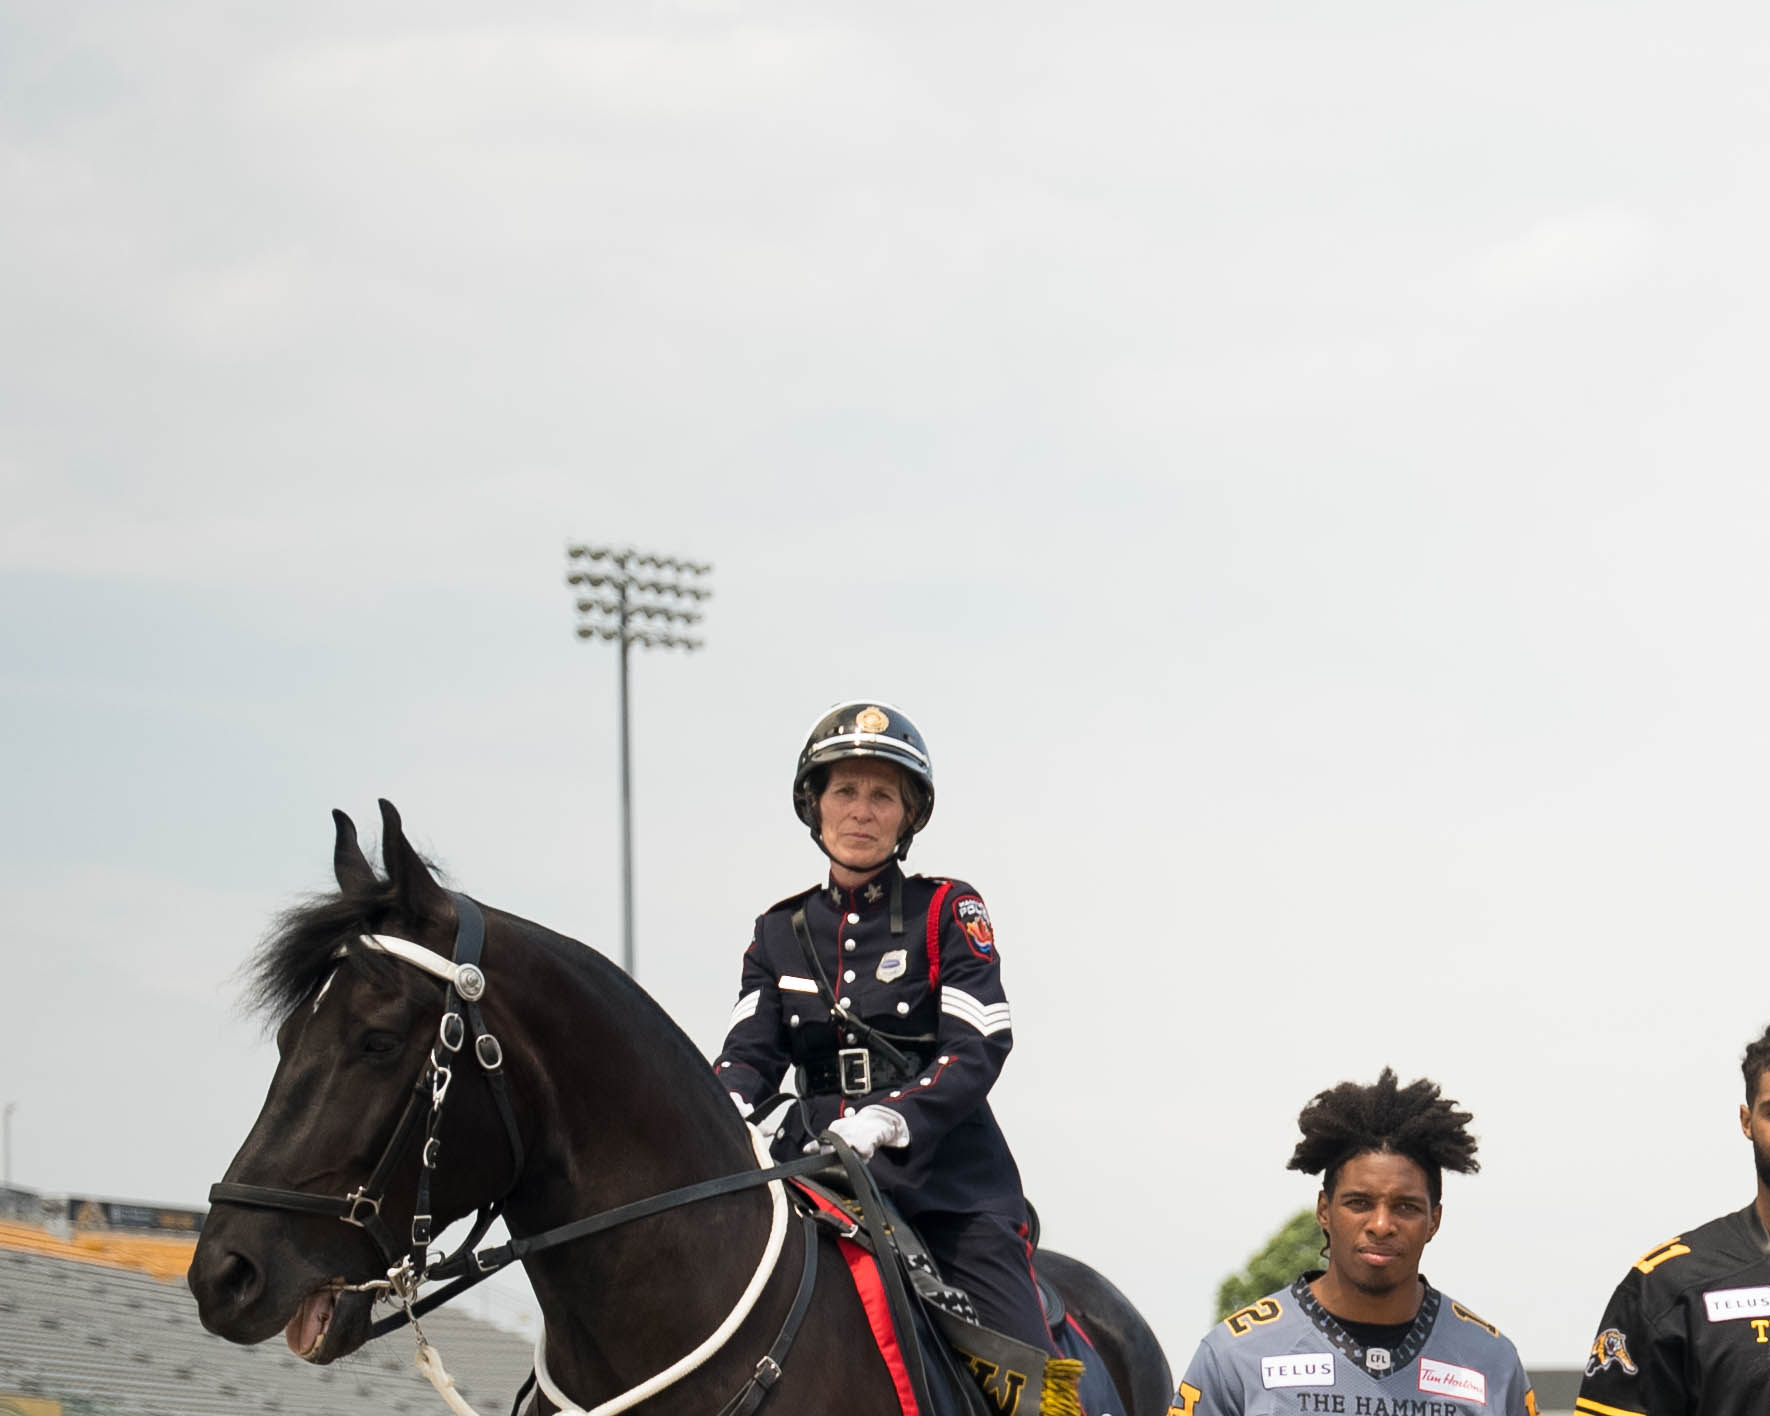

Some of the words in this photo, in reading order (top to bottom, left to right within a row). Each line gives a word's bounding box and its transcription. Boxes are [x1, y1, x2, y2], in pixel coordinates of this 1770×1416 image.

[1713, 1297, 1770, 1311] TELUS
[1370, 1353, 1387, 1365] CFL
[1263, 1363, 1332, 1378] TELUS
[1421, 1367, 1442, 1385] Tim
[1296, 1392, 1346, 1414] THE
